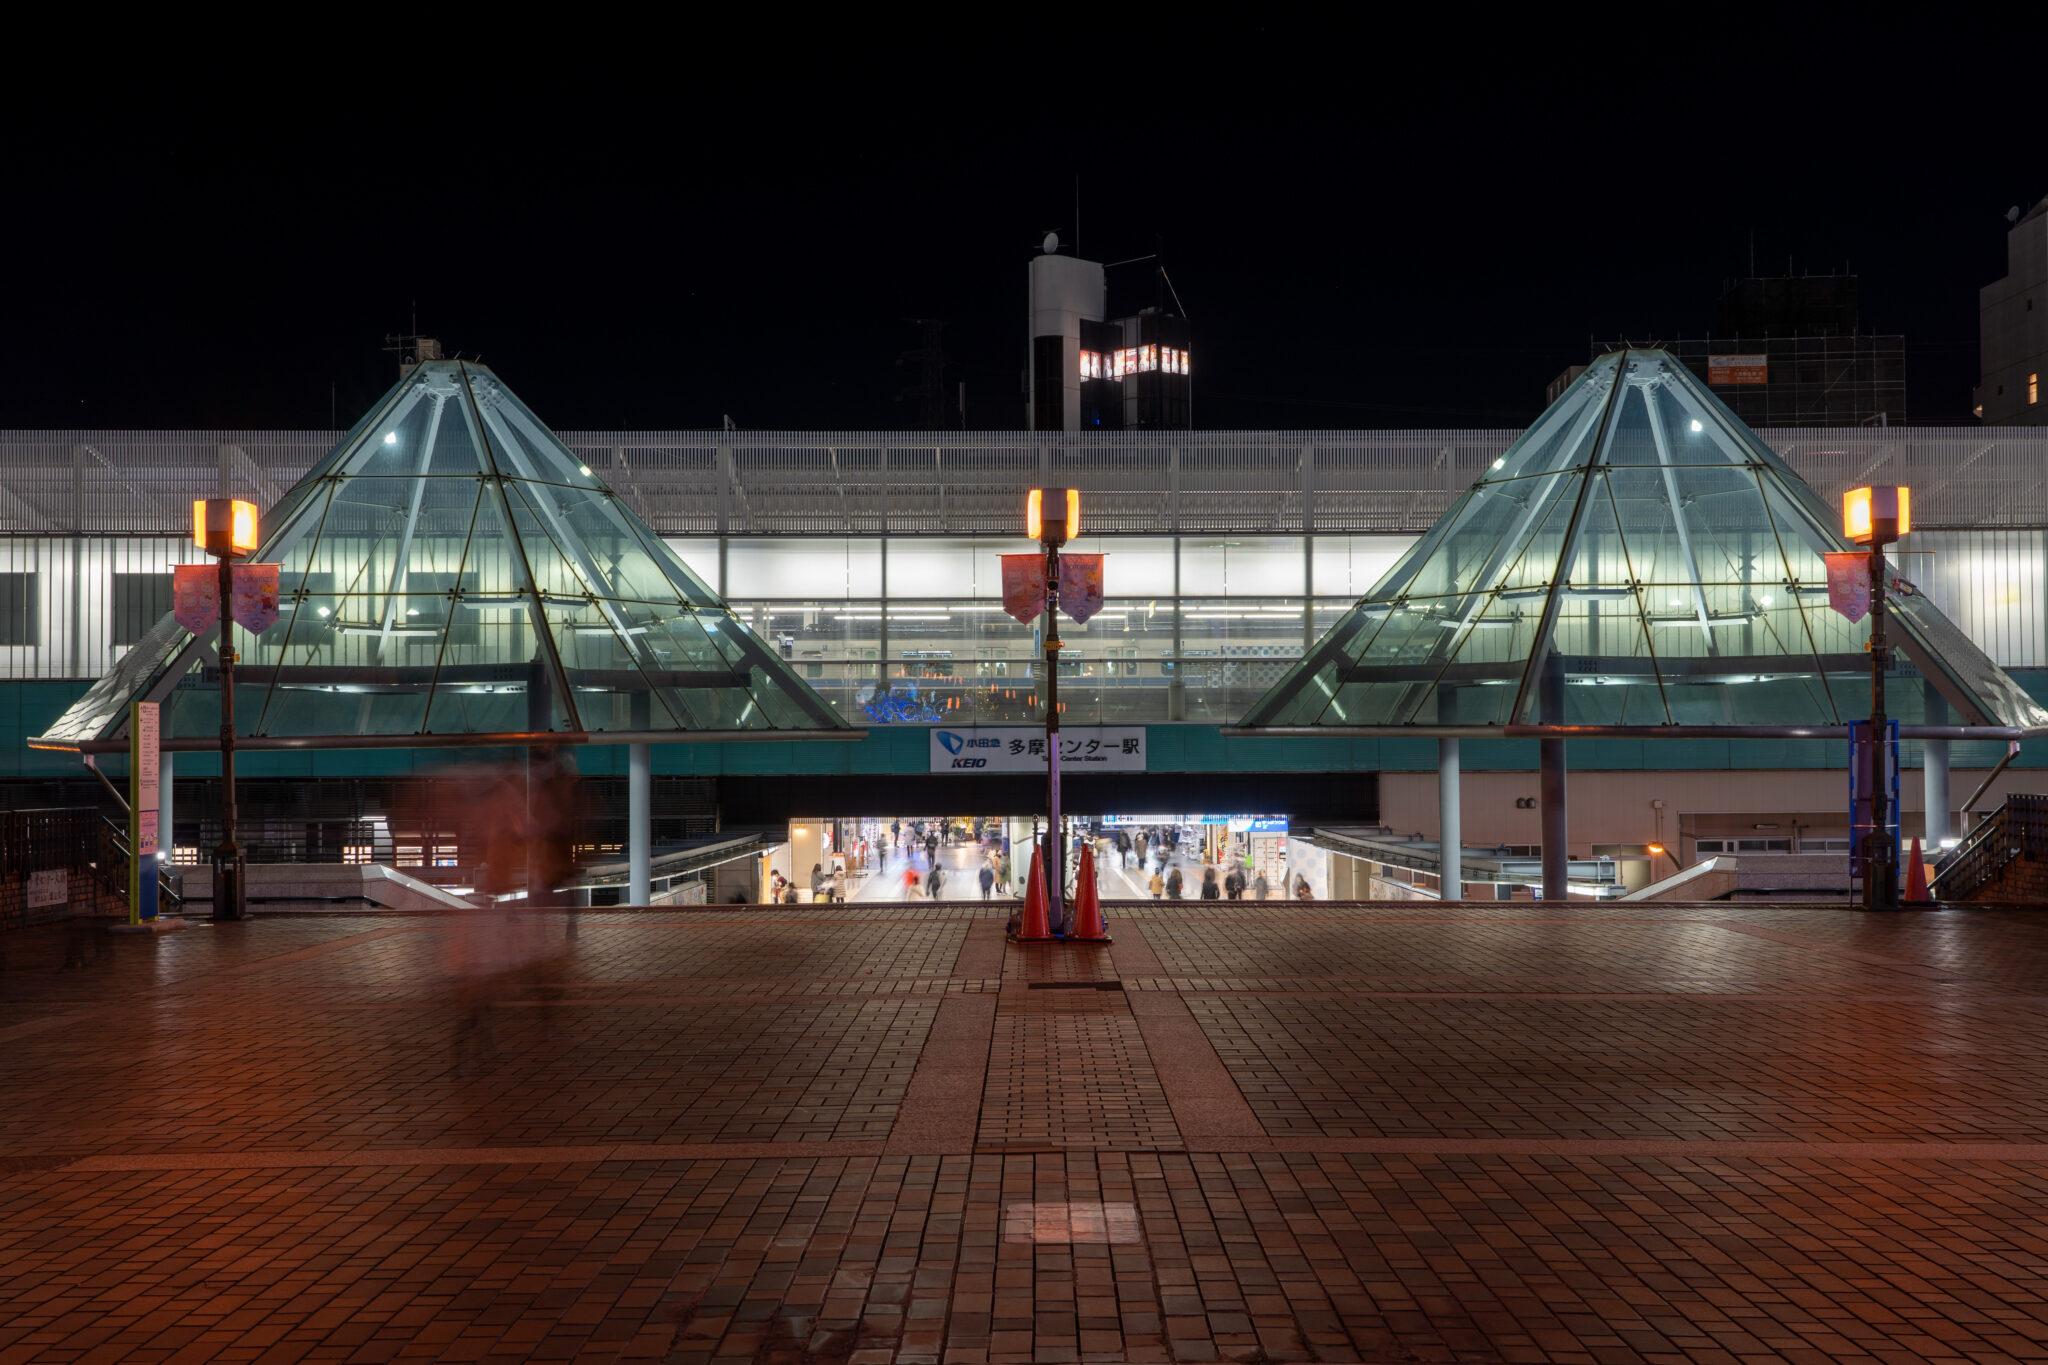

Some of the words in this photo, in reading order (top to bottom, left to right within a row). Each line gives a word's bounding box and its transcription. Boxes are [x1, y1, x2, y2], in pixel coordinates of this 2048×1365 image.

[966, 738, 1001, 748] 小田急
[1008, 738, 1140, 756] 多摩ンター駅
[951, 758, 987, 768] KEIO
